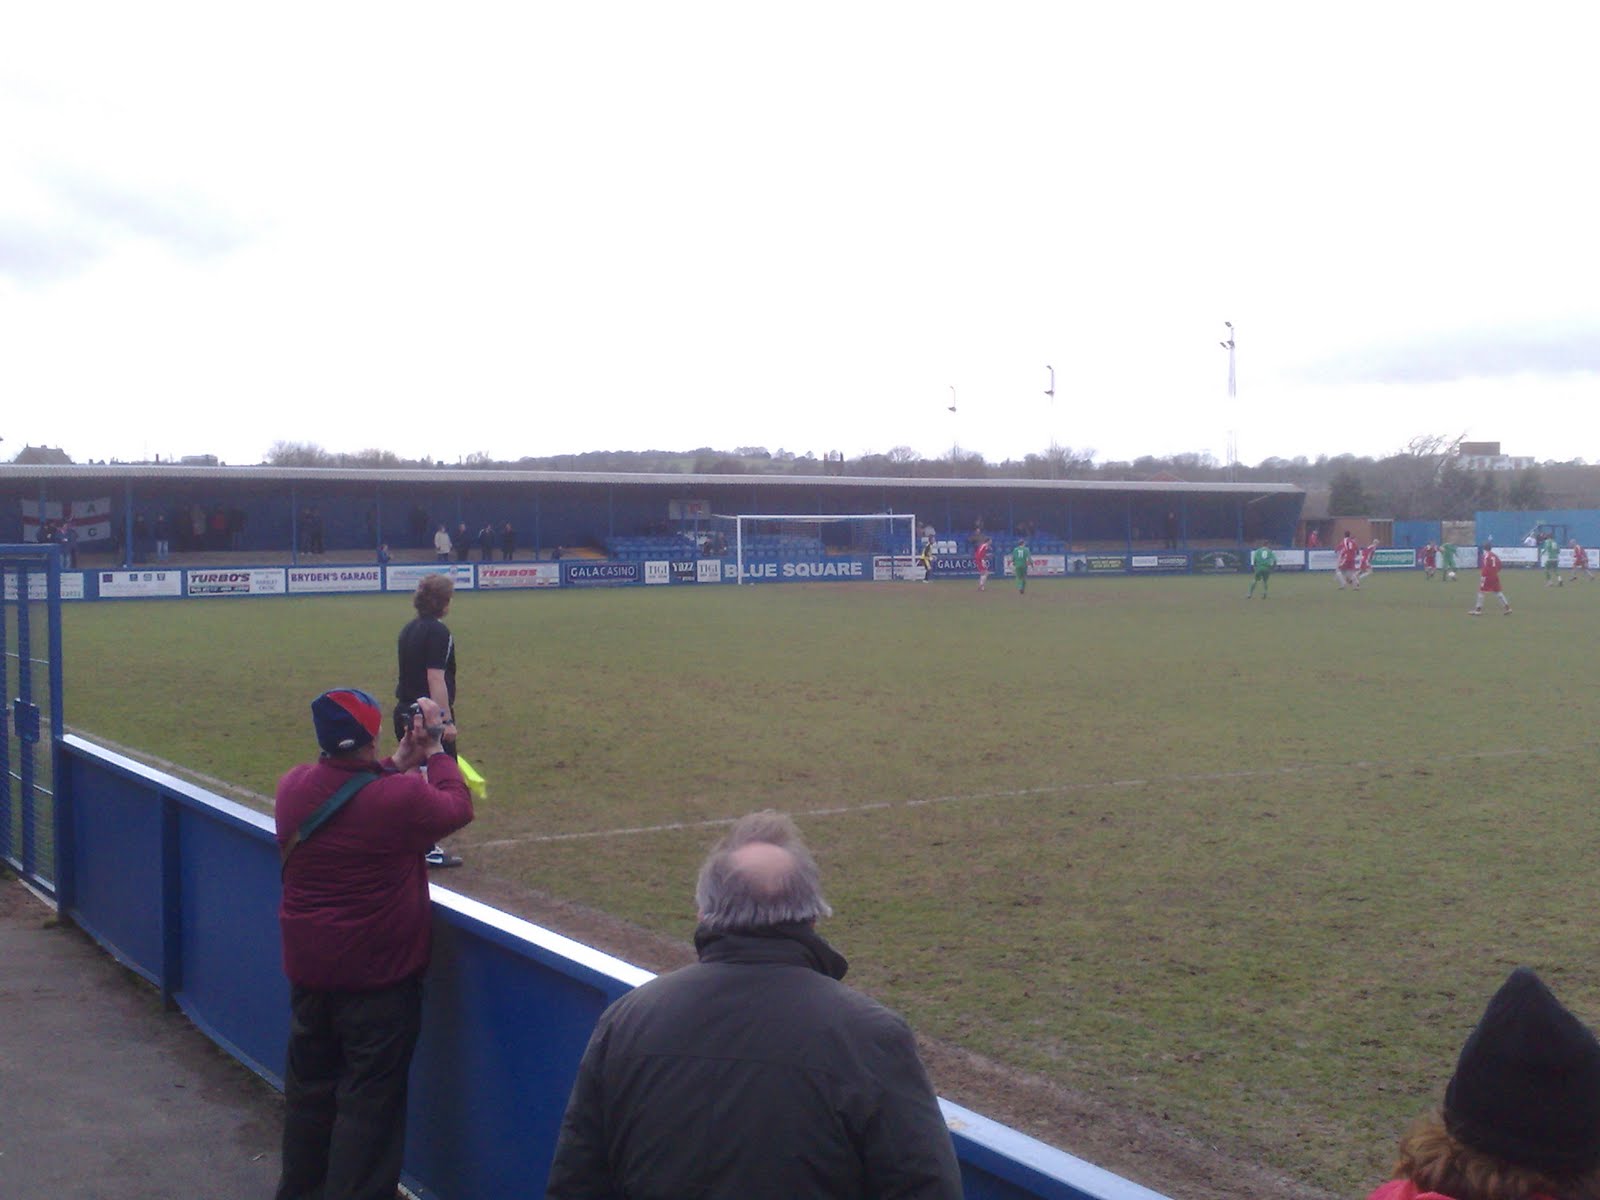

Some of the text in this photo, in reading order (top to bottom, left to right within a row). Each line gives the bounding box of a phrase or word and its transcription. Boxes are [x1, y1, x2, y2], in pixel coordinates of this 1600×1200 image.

[724, 563, 777, 578] BLUE
[782, 562, 862, 577] SQUARE
[190, 573, 250, 582] TURBO'S
[291, 573, 338, 582] BRYDEN'S
[340, 572, 379, 581] GARAGE
